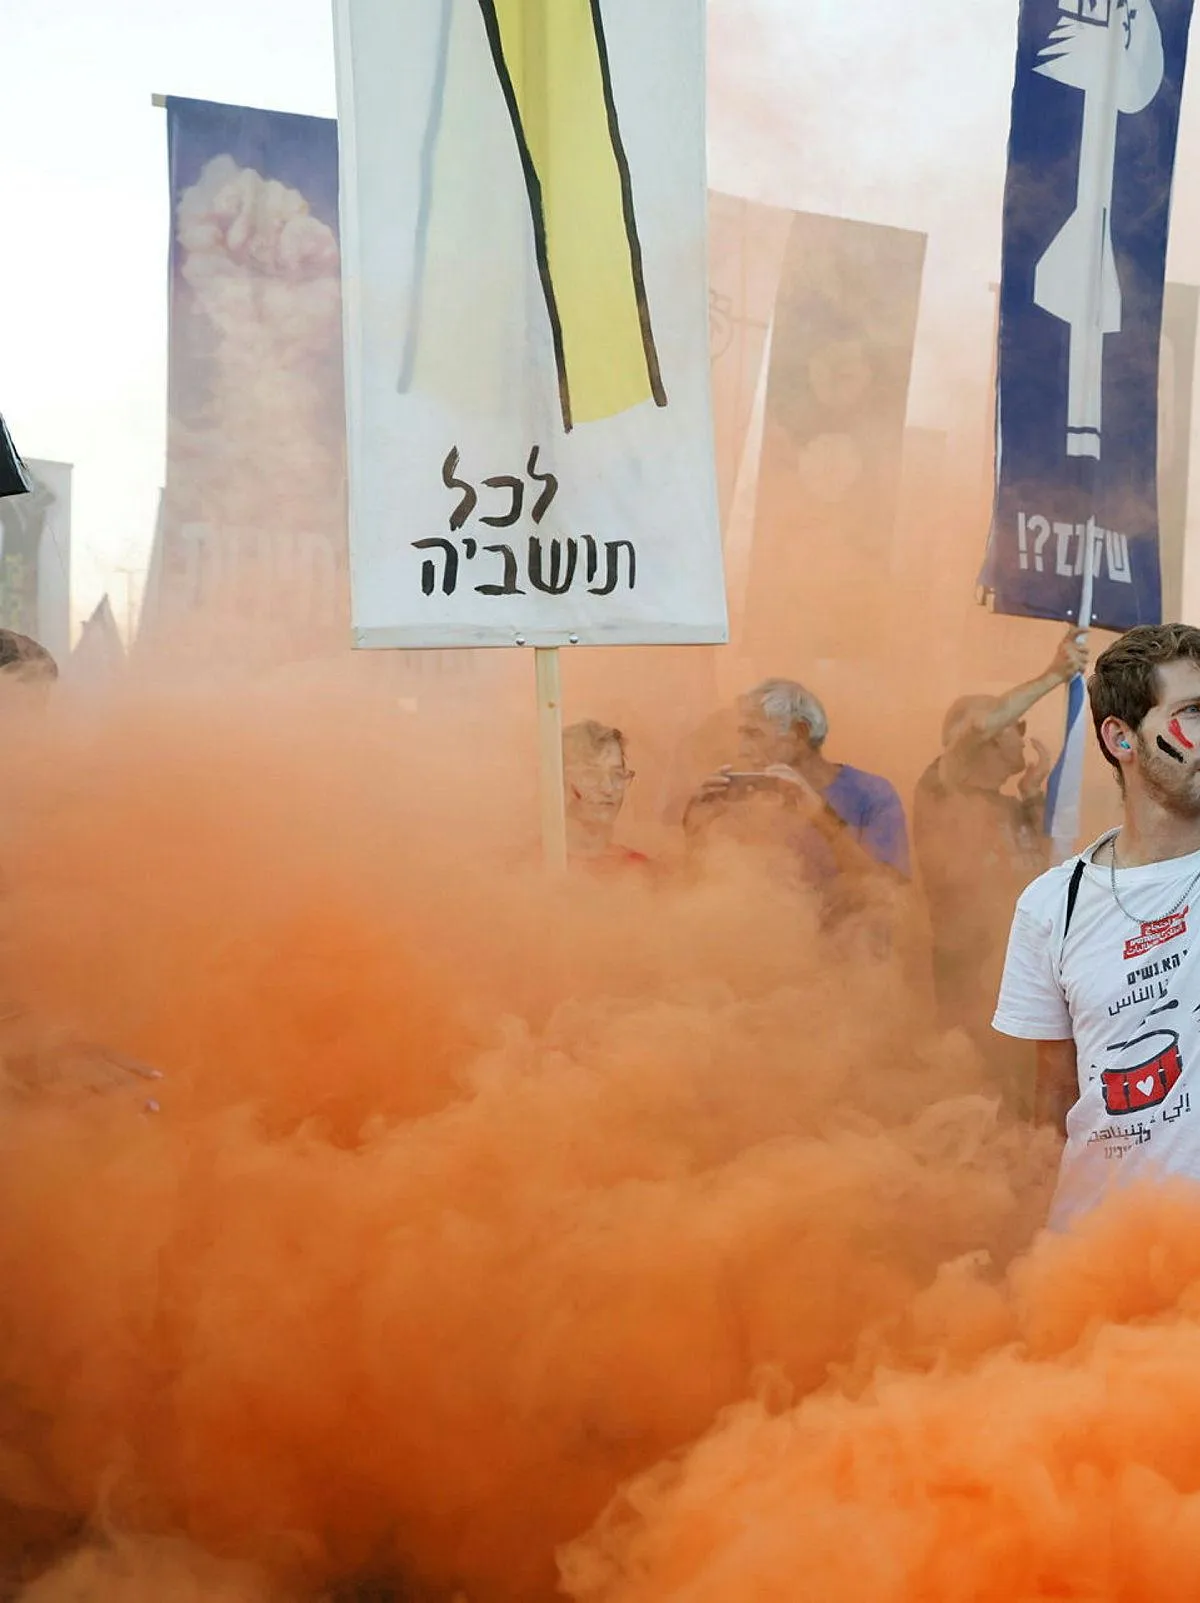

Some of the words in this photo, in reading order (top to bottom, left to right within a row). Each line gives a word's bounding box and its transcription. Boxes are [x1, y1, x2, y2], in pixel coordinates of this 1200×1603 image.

[442, 446, 558, 532] לכל
[411, 535, 636, 596] תושביה
[1018, 511, 1132, 583] שלם?!
